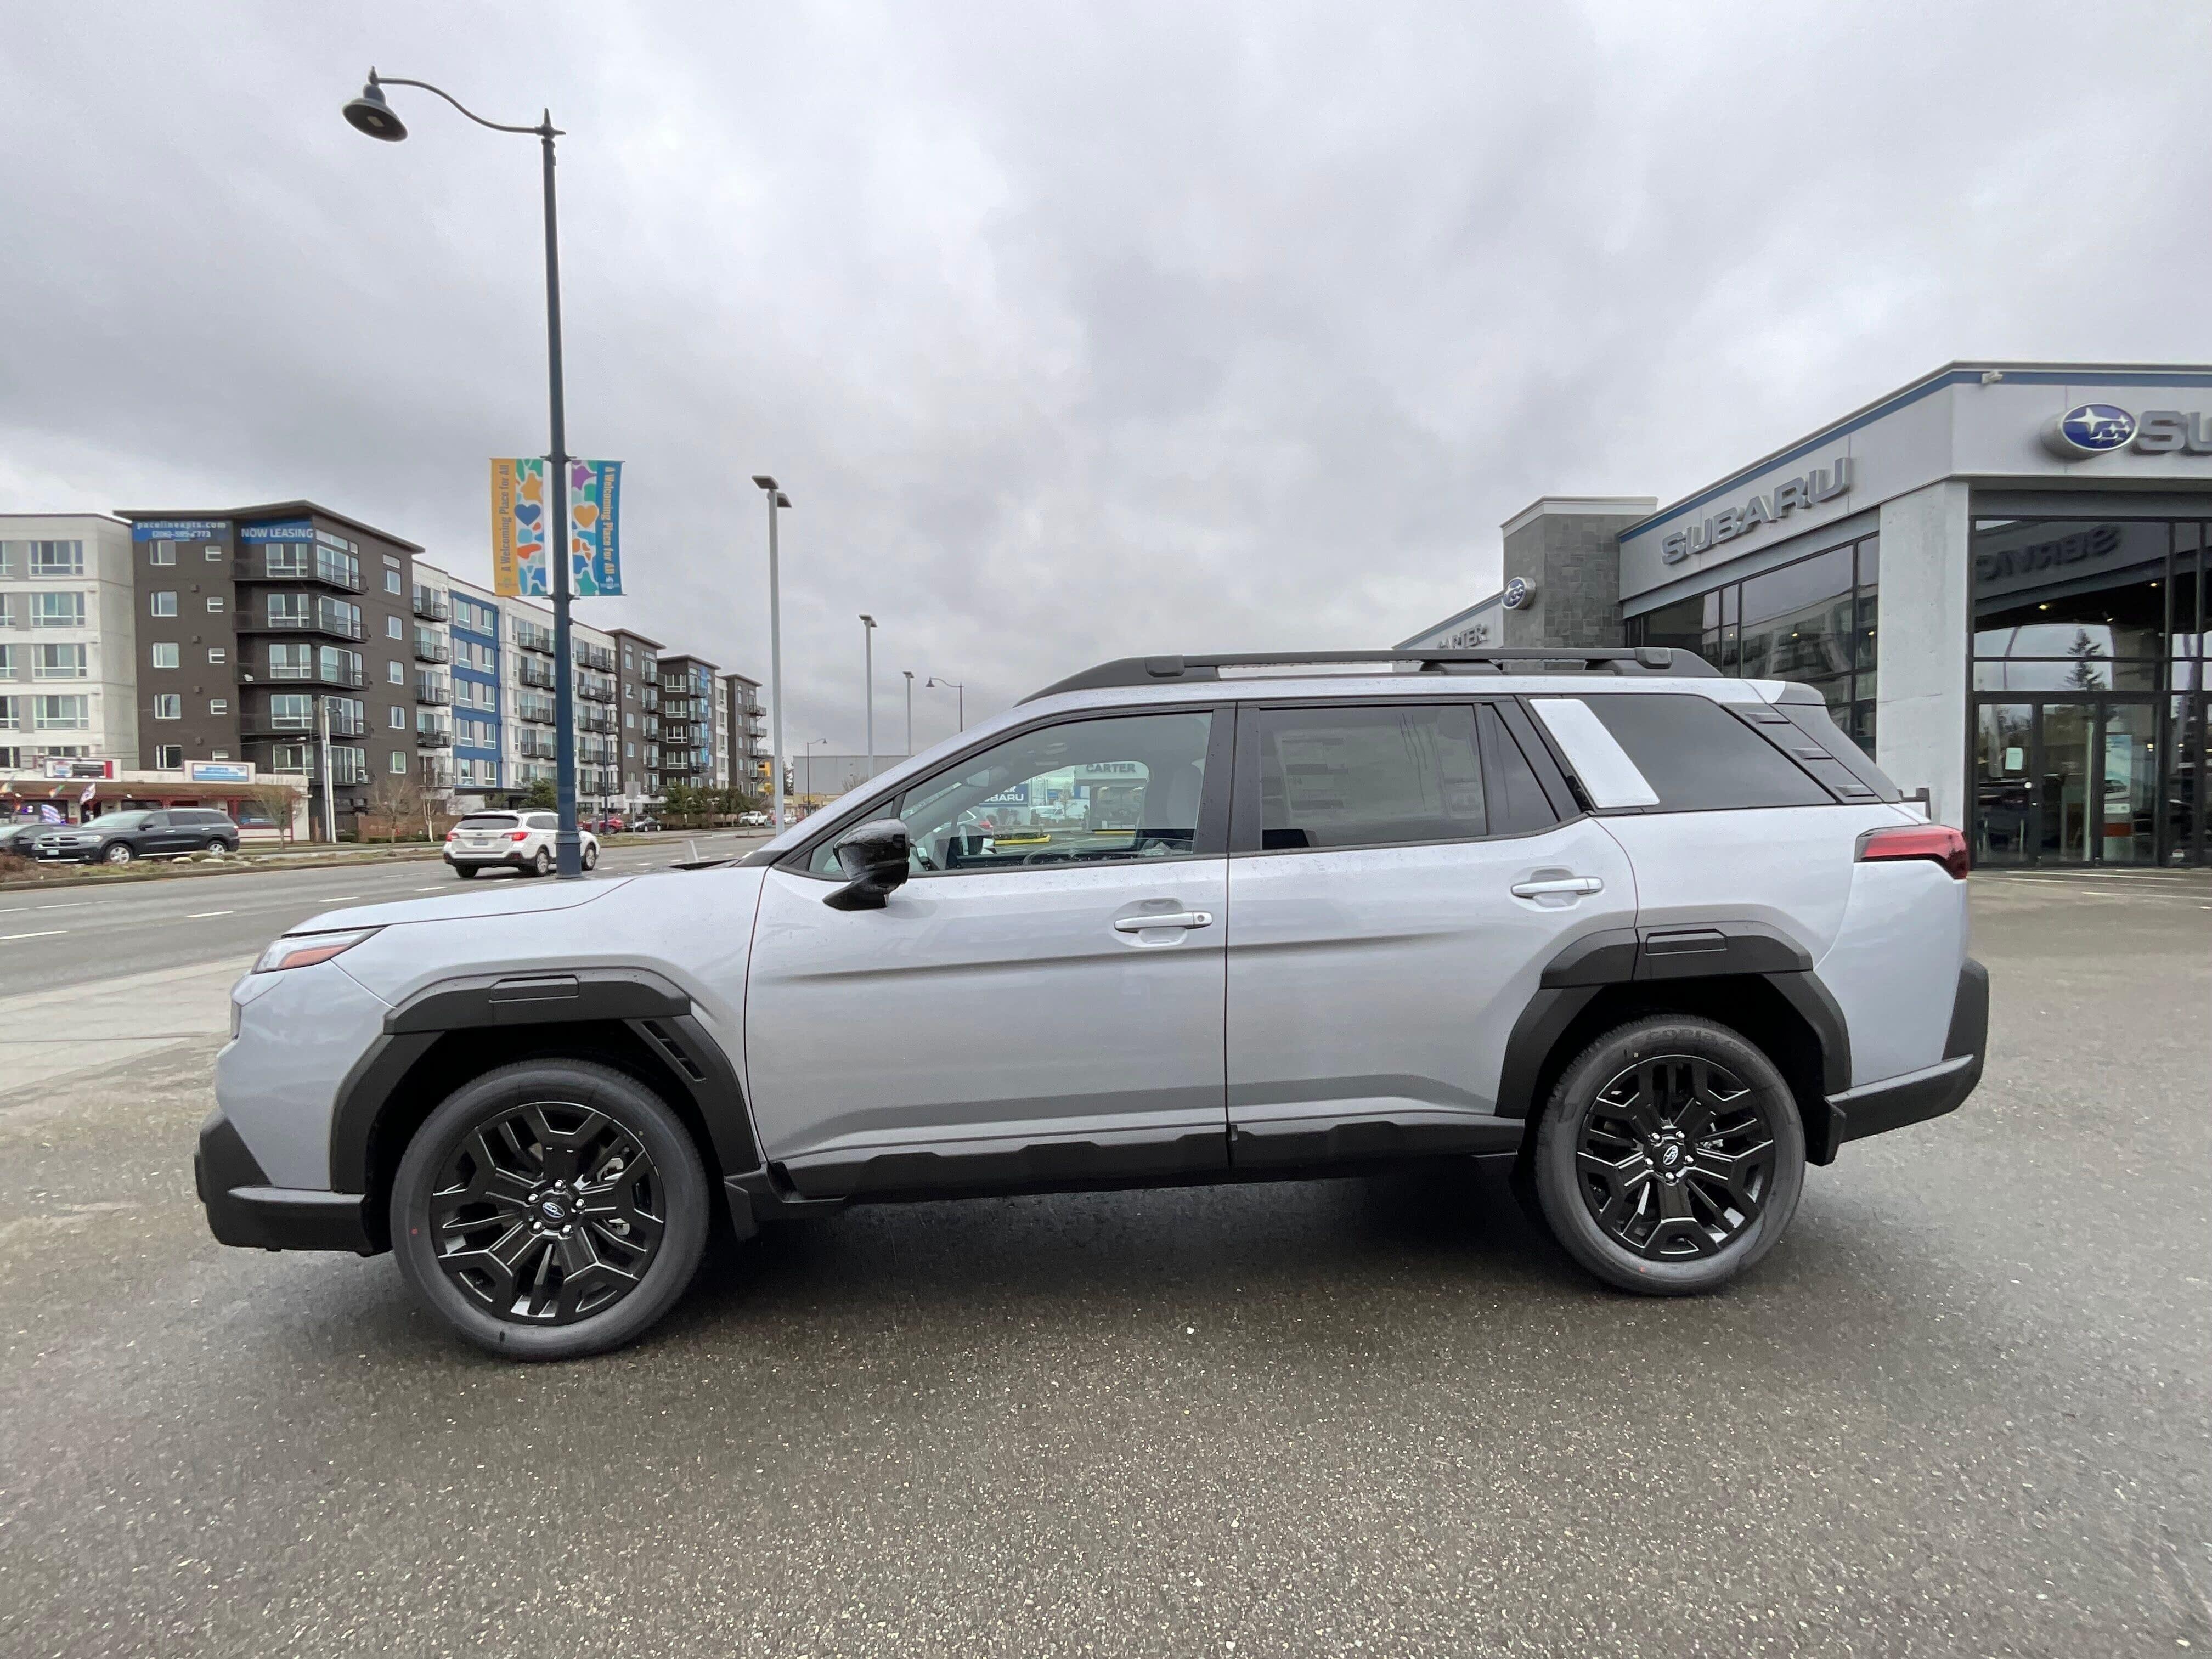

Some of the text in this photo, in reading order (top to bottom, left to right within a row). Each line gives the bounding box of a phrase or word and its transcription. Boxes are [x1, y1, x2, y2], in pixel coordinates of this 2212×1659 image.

[499, 465, 510, 475] All
[499, 477, 510, 489] for
[499, 492, 510, 514] Place
[601, 474, 615, 521] Welcoming
[1662, 457, 1850, 565] SUBARU
[241, 528, 314, 539] NOW LEASING
[603, 522, 614, 545] Place
[499, 517, 512, 564] Welcoming
[603, 548, 614, 561] for
[605, 563, 615, 574] All
[1086, 763, 1136, 773] CARTER
